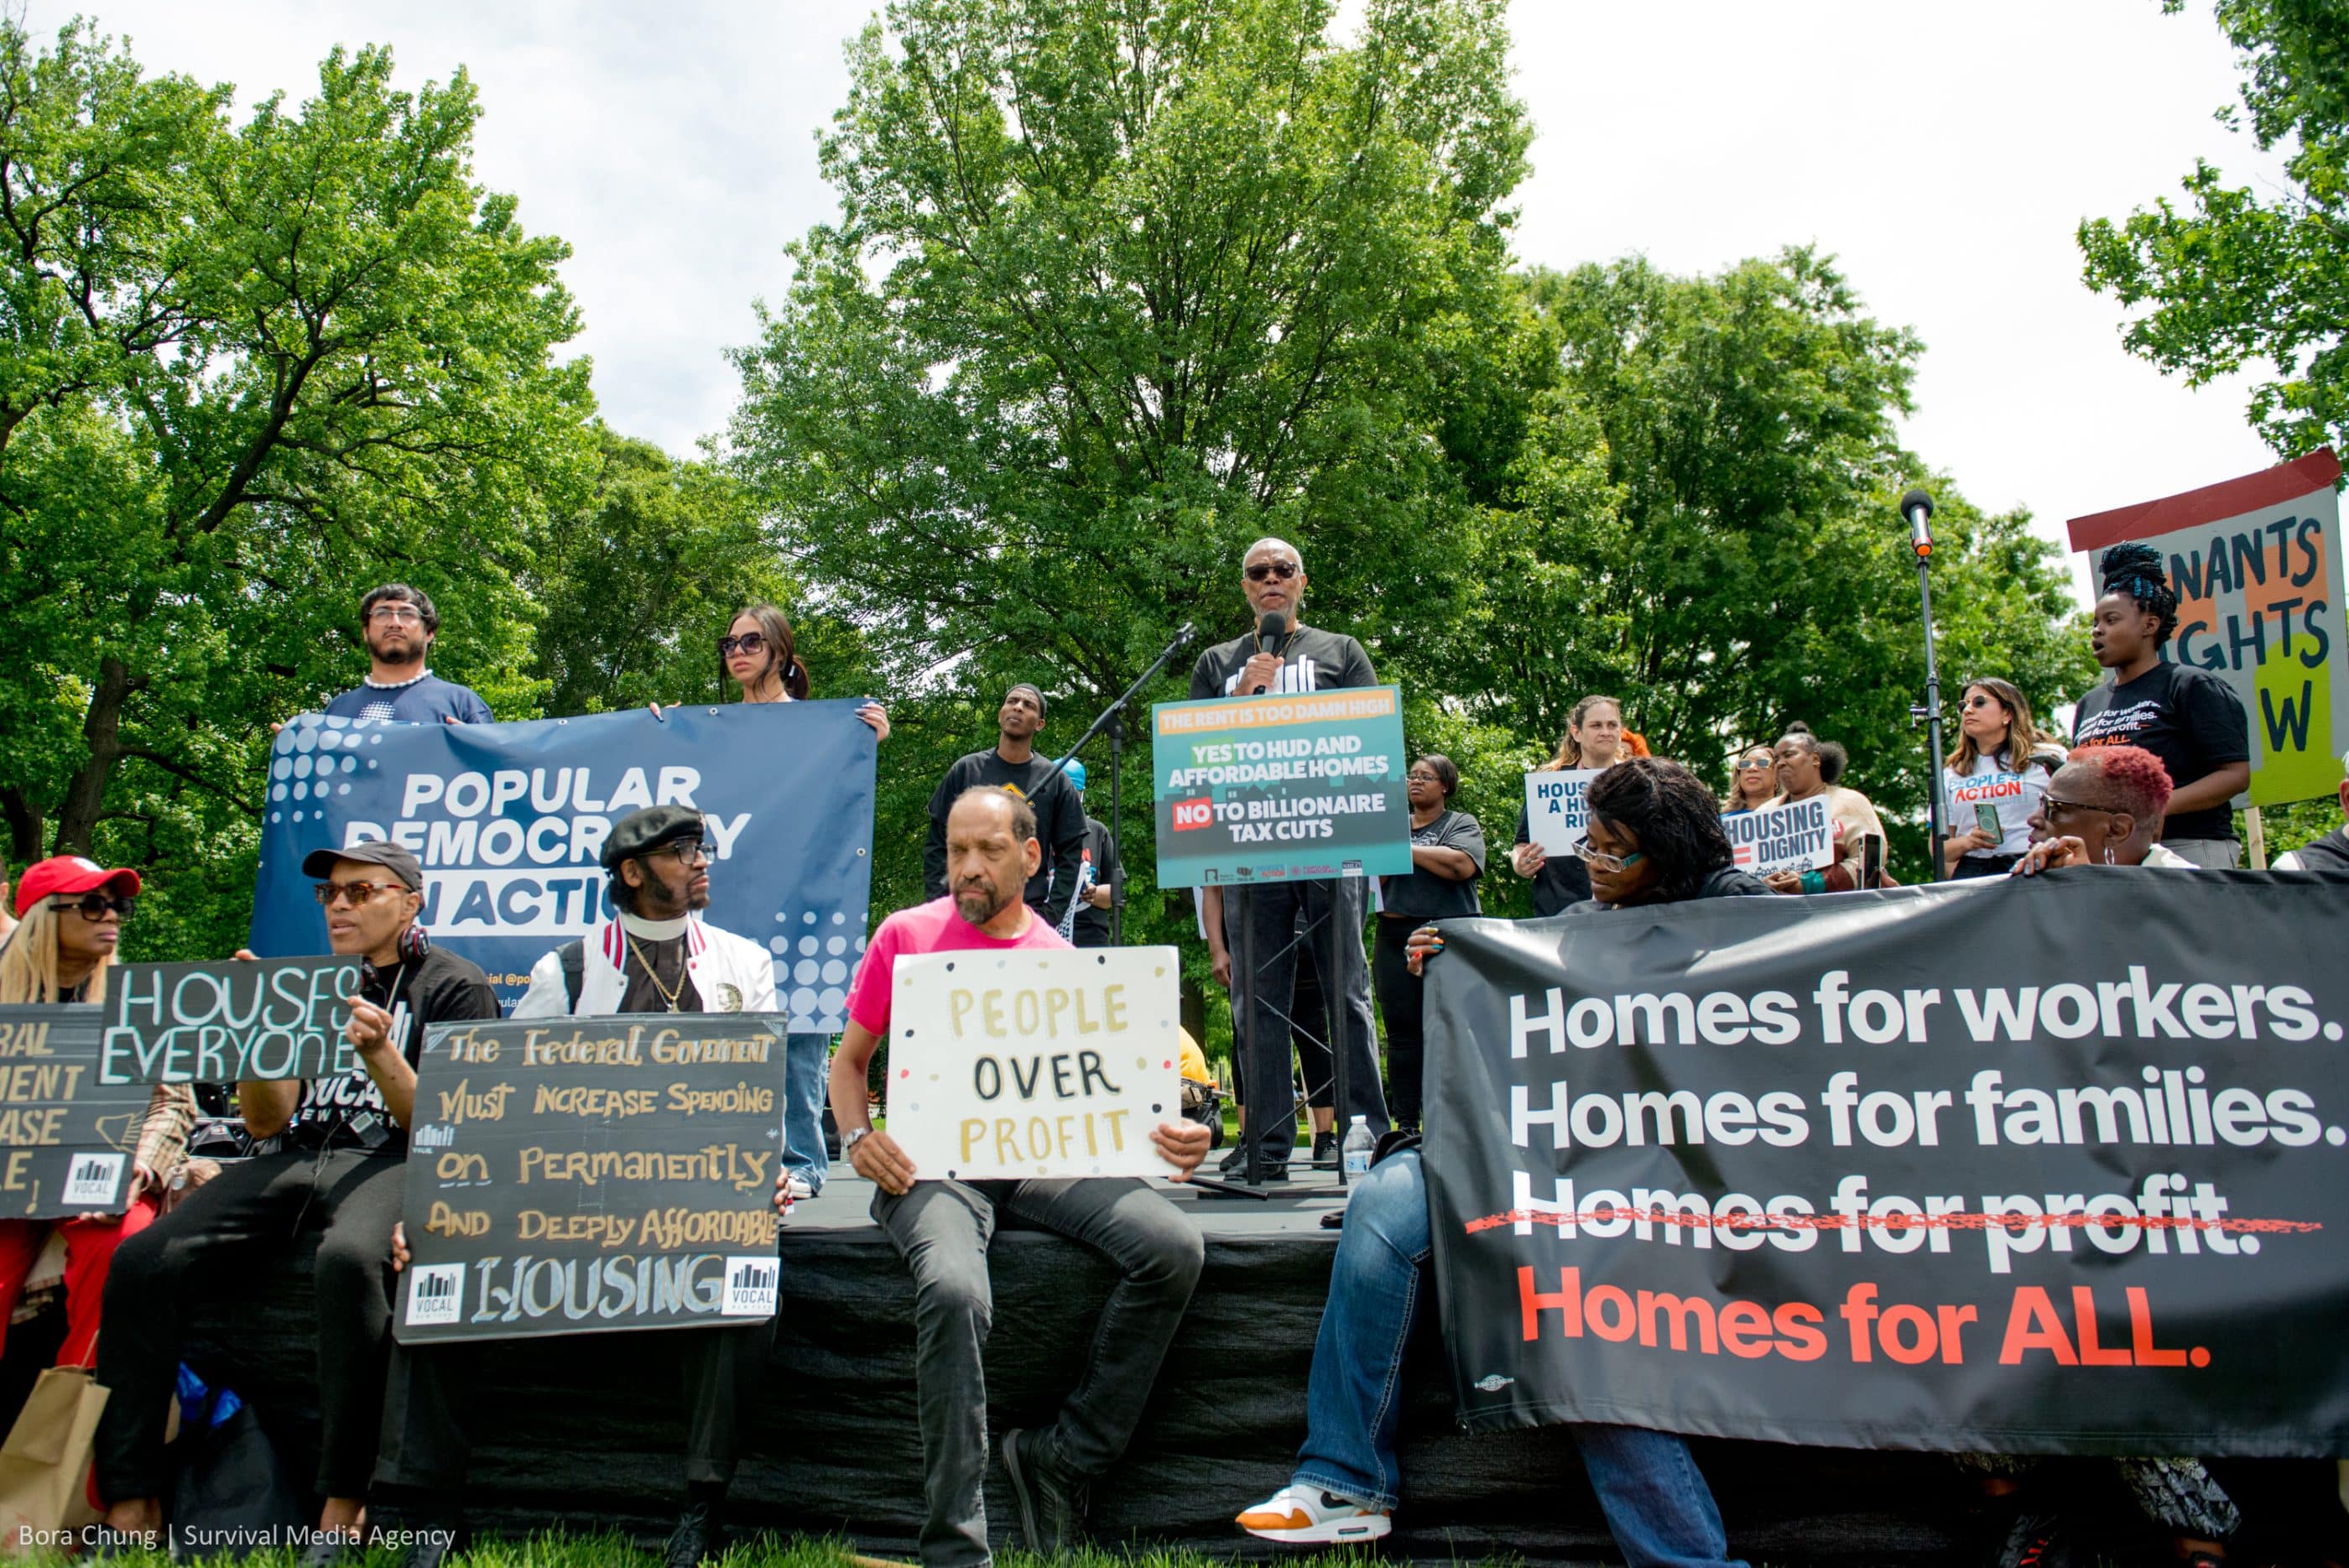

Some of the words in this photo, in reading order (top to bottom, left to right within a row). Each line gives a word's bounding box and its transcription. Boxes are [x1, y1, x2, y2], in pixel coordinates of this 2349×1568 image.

[2169, 516, 2321, 605] NANTS
[2159, 597, 2330, 669] GHTS
[1161, 712, 1192, 729] THE
[1195, 709, 1235, 727] RENT
[1239, 708, 1254, 724] IS
[1255, 705, 1293, 722] TOO
[1295, 701, 1346, 719] DAMN
[1348, 697, 1390, 715] HIGH
[1169, 760, 1307, 788] AFFORDABLE
[1308, 755, 1389, 779] HOMES
[1192, 743, 1233, 763] YES
[1233, 741, 1264, 761] TO
[1267, 738, 1312, 759] HUD
[1314, 735, 1362, 755] AND
[401, 765, 701, 818] POPULAR
[1175, 803, 1211, 826] NO
[1212, 801, 1245, 822] TO
[1247, 793, 1386, 820] BILLIONAIRE
[1549, 799, 1561, 813] A
[1955, 780, 2022, 804] ACTION
[343, 812, 753, 867] DEMOCRY
[1228, 821, 1273, 843] TAX
[1275, 818, 1333, 840] CUTS
[1723, 801, 1825, 846] HOUSING
[1758, 828, 1826, 864] DIGNITY
[451, 877, 616, 926] ACTI
[950, 983, 1128, 1039] PEOPLE
[1510, 986, 1801, 1059] Homes
[1812, 970, 1940, 1044] for
[1953, 965, 2344, 1042] workers.
[448, 1025, 501, 1064] The
[521, 1024, 646, 1067] Federal
[973, 1050, 1122, 1102] OVER
[299, 1107, 332, 1123] EW
[339, 1108, 400, 1128] YRK
[1511, 1080, 1810, 1150] Homes
[1821, 1071, 1952, 1147] for
[1965, 1065, 2346, 1147] families.
[959, 1109, 1129, 1164] PROFIT
[1513, 1169, 1819, 1253] Homes
[1831, 1175, 1965, 1253] for
[1982, 1172, 2261, 1274] profit.
[416, 1298, 454, 1313] VOCAL
[470, 1254, 724, 1324] HOUSING
[732, 1289, 773, 1304] VOCAL
[1517, 1264, 1829, 1362] Homes
[1840, 1282, 1978, 1365] for
[1997, 1285, 2211, 1368] ALL.
